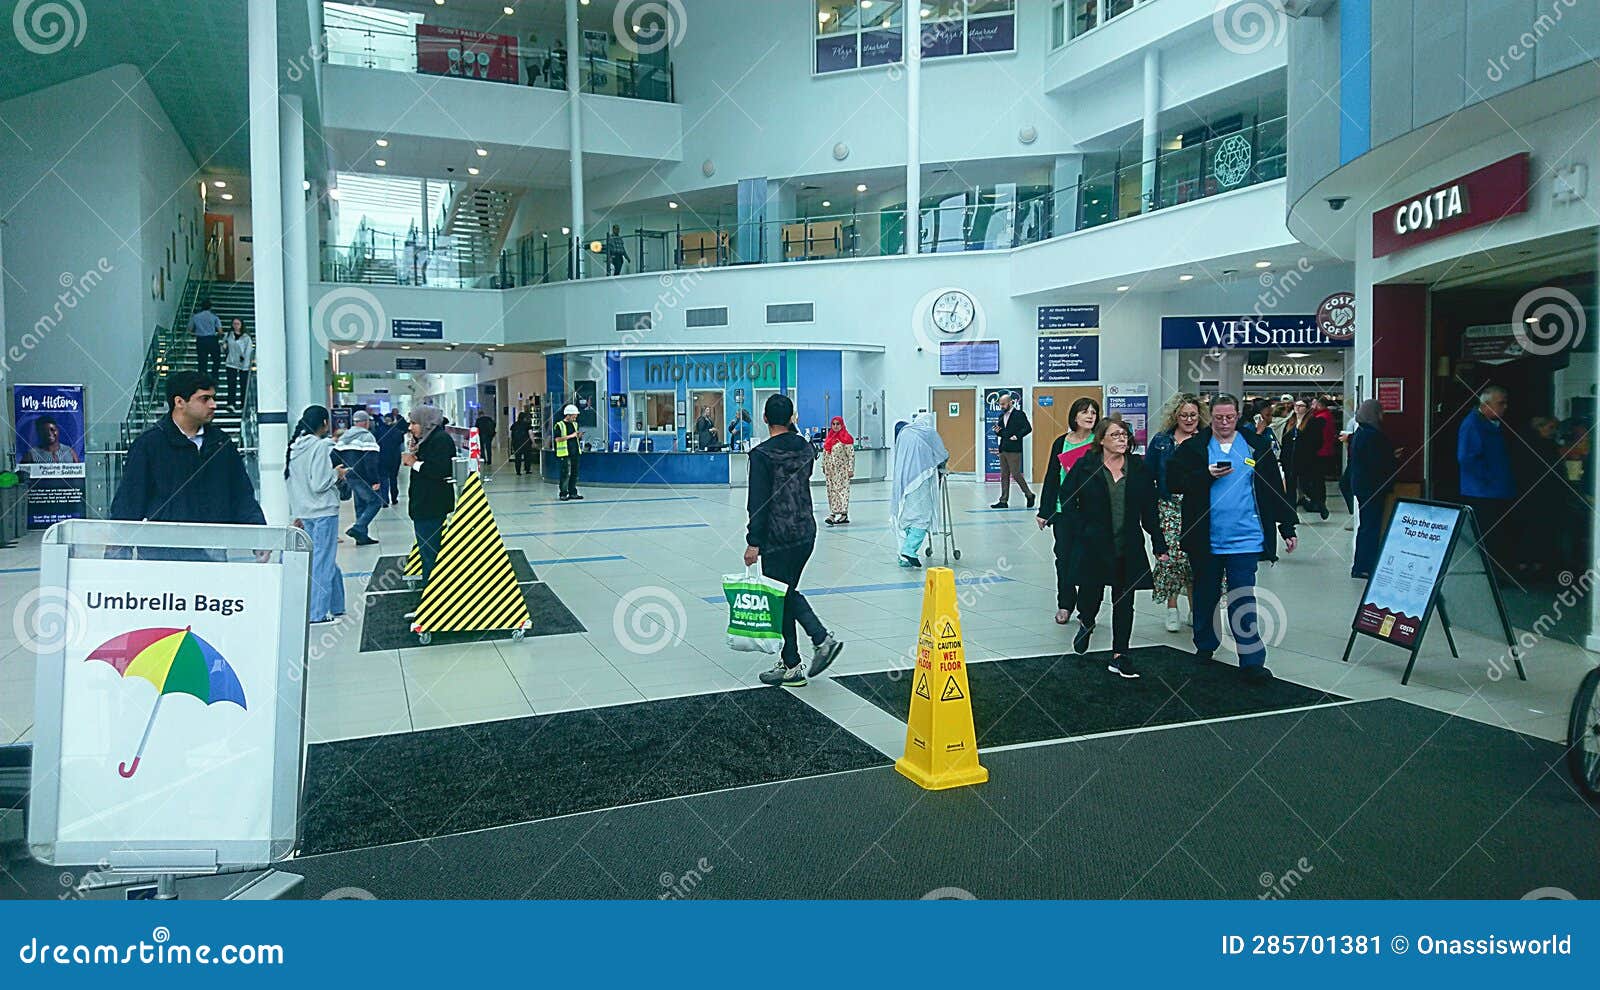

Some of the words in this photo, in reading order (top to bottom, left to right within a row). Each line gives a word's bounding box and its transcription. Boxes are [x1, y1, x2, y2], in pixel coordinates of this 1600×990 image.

[1396, 184, 1464, 235] COSTA
[1196, 320, 1331, 345] WHSmith
[1323, 321, 1355, 335] COFFE
[644, 357, 777, 383] Information
[1243, 363, 1265, 376] M&S
[1266, 363, 1294, 376] FOOD
[1295, 363, 1307, 376] TO
[1308, 363, 1324, 376] GO
[22, 395, 38, 410] My
[42, 395, 78, 410] History
[1402, 515, 1418, 527] Skip
[1419, 520, 1430, 528] the
[1404, 527, 1416, 537] Tap
[1417, 531, 1429, 539] the
[87, 592, 187, 611] Umbrella
[194, 594, 244, 617] Bags
[733, 593, 770, 611] ASDA
[1400, 624, 1414, 633] COSTA
[938, 641, 961, 650] CAUTION
[921, 648, 930, 660] WET
[943, 651, 957, 661] WET
[918, 659, 931, 670] FLOOR
[940, 661, 961, 673] FLOOR
